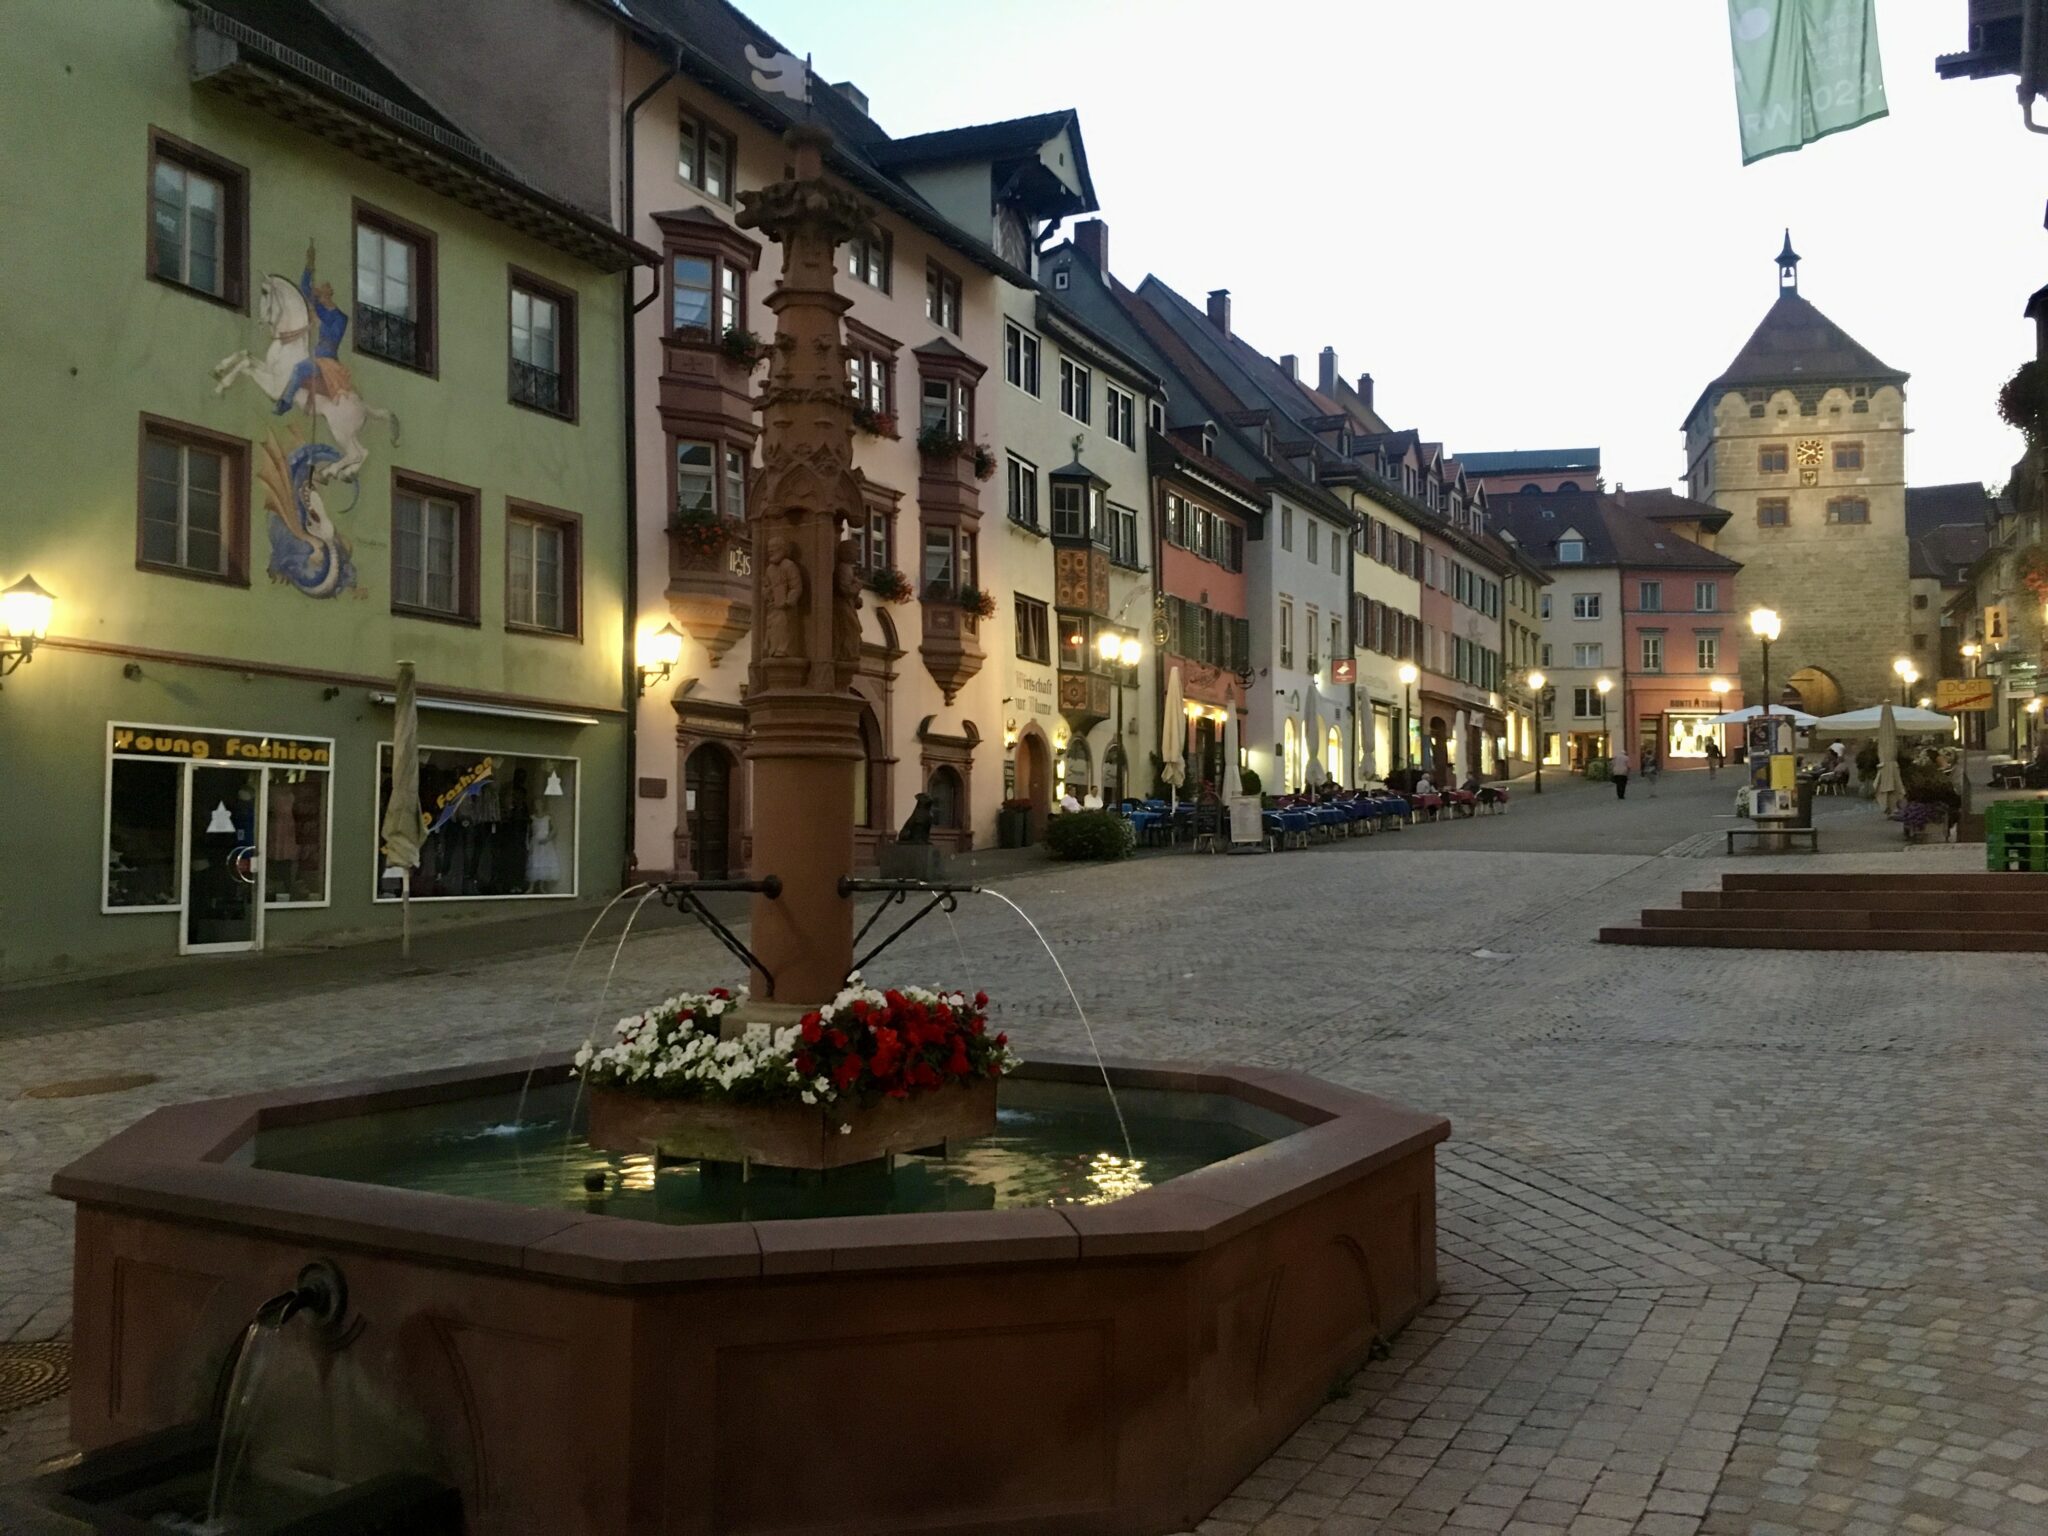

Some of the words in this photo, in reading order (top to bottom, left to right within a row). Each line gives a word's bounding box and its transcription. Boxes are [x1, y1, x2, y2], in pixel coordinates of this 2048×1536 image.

[1946, 680, 1983, 693] DORT
[113, 729, 209, 759] Young
[226, 737, 329, 762] Fashion
[436, 756, 494, 809] Fashion
